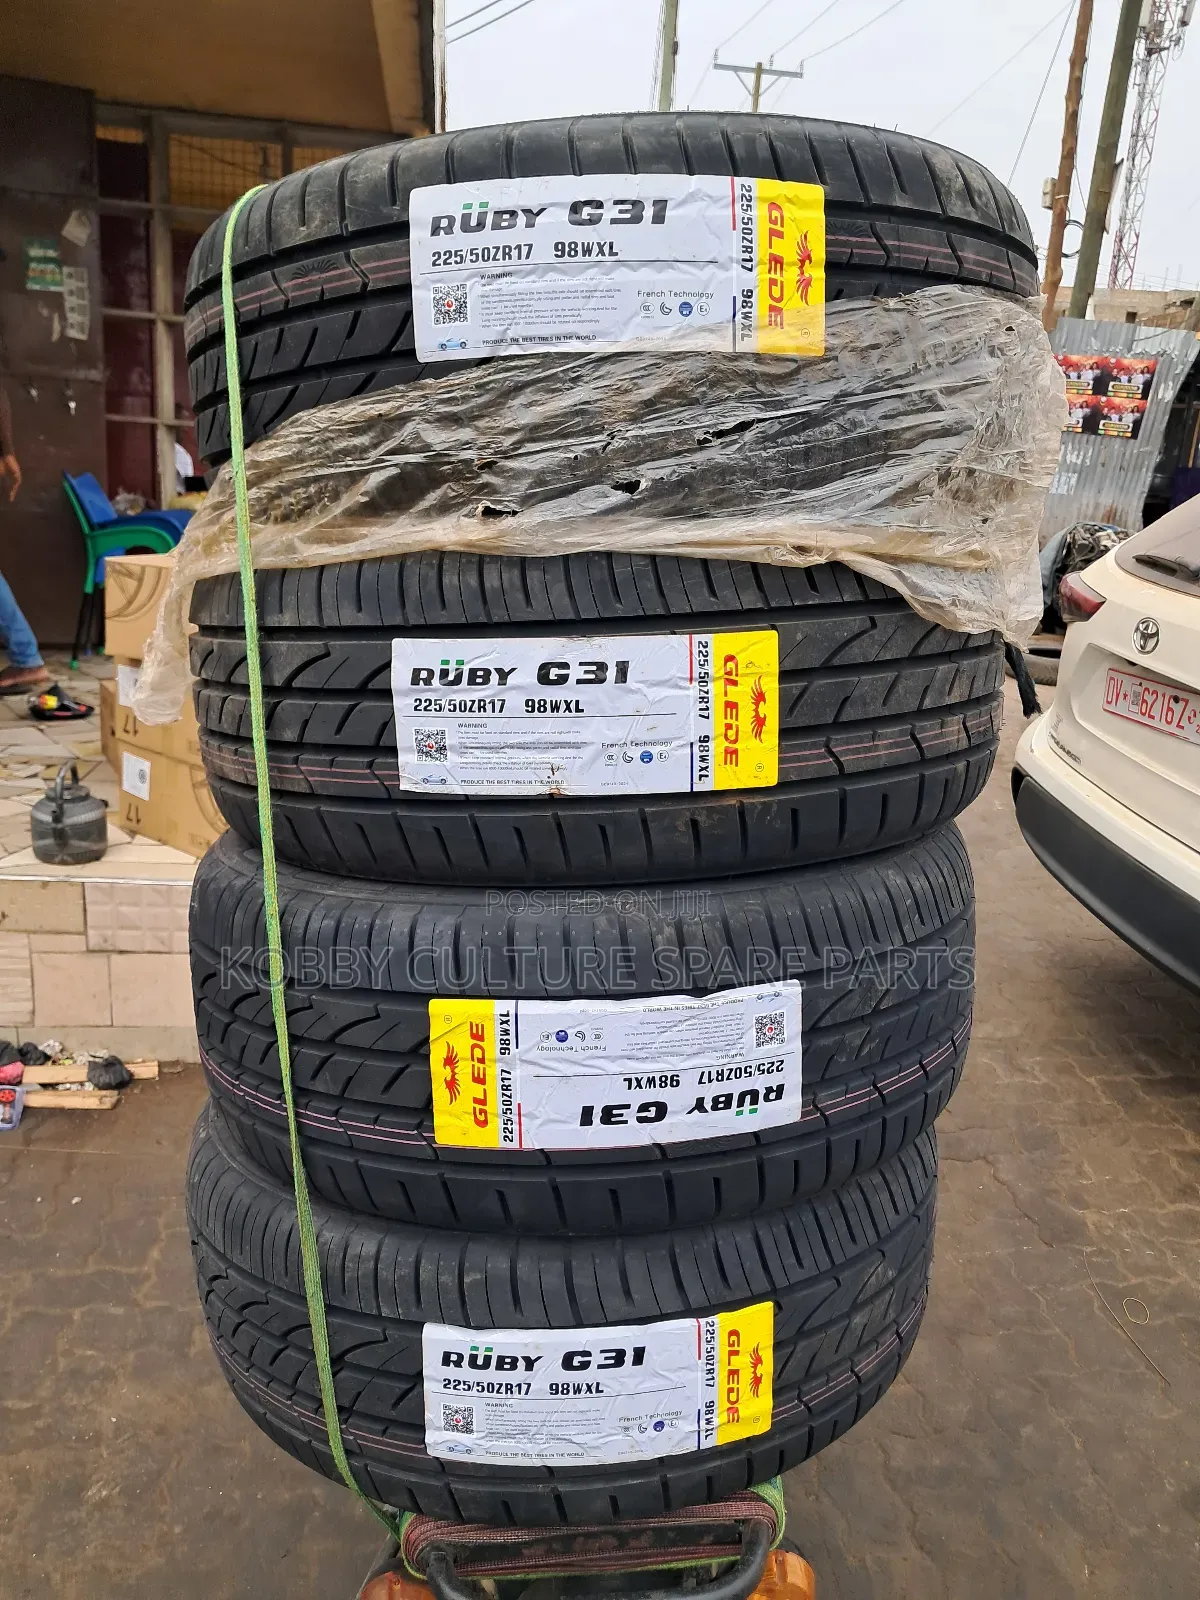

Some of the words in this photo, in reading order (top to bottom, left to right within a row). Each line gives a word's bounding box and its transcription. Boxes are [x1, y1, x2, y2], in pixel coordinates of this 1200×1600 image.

[738, 183, 754, 274] 225/50ZR17
[431, 243, 534, 267] 225/50ZR17
[553, 240, 619, 259] 98WXL
[767, 202, 785, 330] GLEDE
[480, 272, 513, 280] WARNING
[637, 290, 666, 298] French
[668, 290, 714, 299] Technology
[738, 288, 754, 342] 98WXL
[482, 338, 508, 346] PRODUCE
[697, 640, 709, 720] 225/50ZR17
[1106, 676, 1123, 706] DV
[413, 698, 506, 714] 225/50ZR17
[524, 697, 585, 714] 98WXL
[723, 653, 739, 767] GLEDE
[630, 740, 673, 748] Technology
[697, 734, 709, 782] 98WXL
[722, 998, 744, 1006] PRODUCE
[500, 1010, 512, 1056] 98WXL
[535, 1044, 578, 1054] Technology
[581, 1045, 607, 1053] French
[716, 1052, 745, 1061] WARNING
[471, 1021, 488, 1128] GLEDE
[623, 1072, 681, 1090] 98WXL
[698, 1059, 786, 1085] 225/50ZR17
[502, 1069, 515, 1143] 225/50ZR17
[704, 1320, 716, 1388] 225/50ZR17
[442, 1378, 532, 1396] 225/50ZR17
[549, 1381, 604, 1396] 98WXL
[726, 1329, 741, 1425] GLEDE
[619, 1415, 643, 1423] French
[645, 1410, 683, 1419] Technology
[704, 1400, 715, 1441] 98WXL
